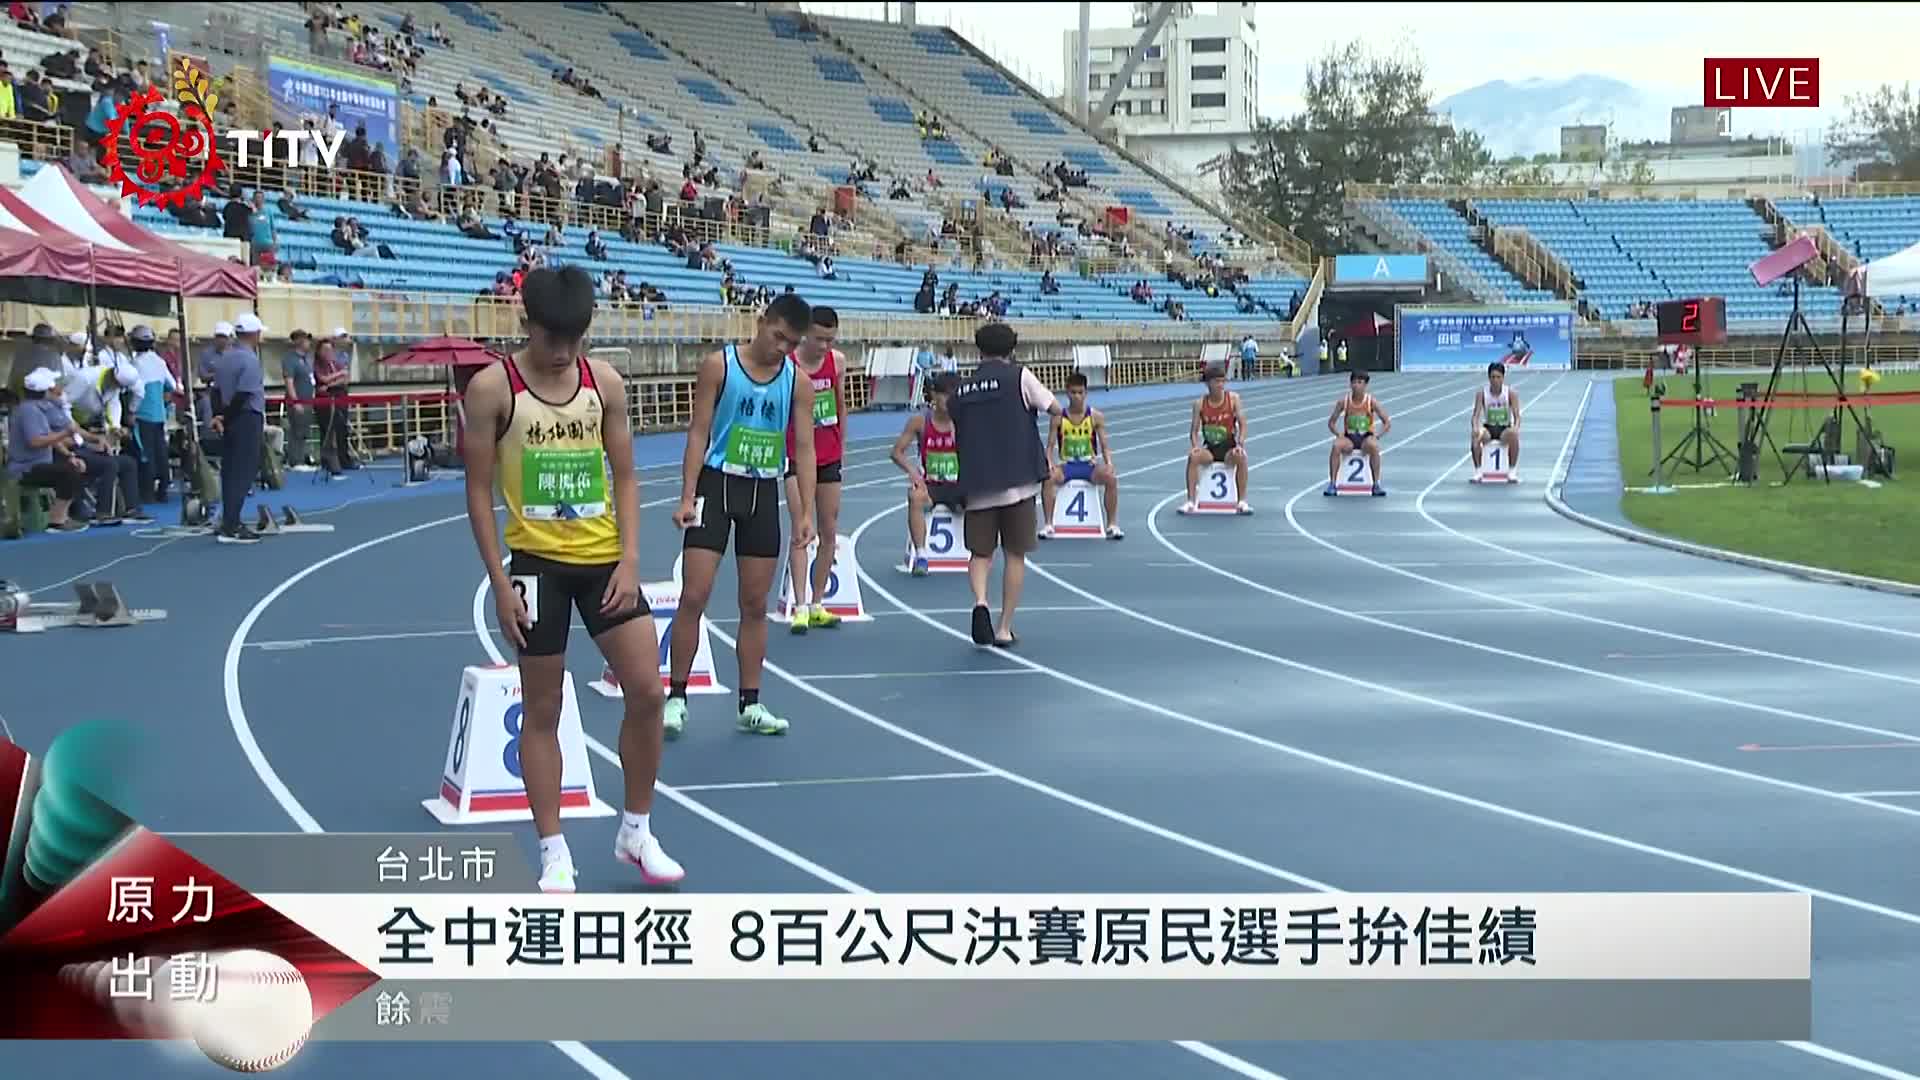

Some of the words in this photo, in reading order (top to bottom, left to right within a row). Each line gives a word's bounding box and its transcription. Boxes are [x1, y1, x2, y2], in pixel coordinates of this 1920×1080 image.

[1373, 259, 1391, 279] A
[1680, 304, 1698, 331] 2
[1347, 458, 1366, 482] 2
[1489, 449, 1502, 471] 1
[1209, 471, 1229, 499] 3
[1065, 490, 1089, 522] 4
[929, 516, 954, 554] 5
[452, 695, 470, 775] 8
